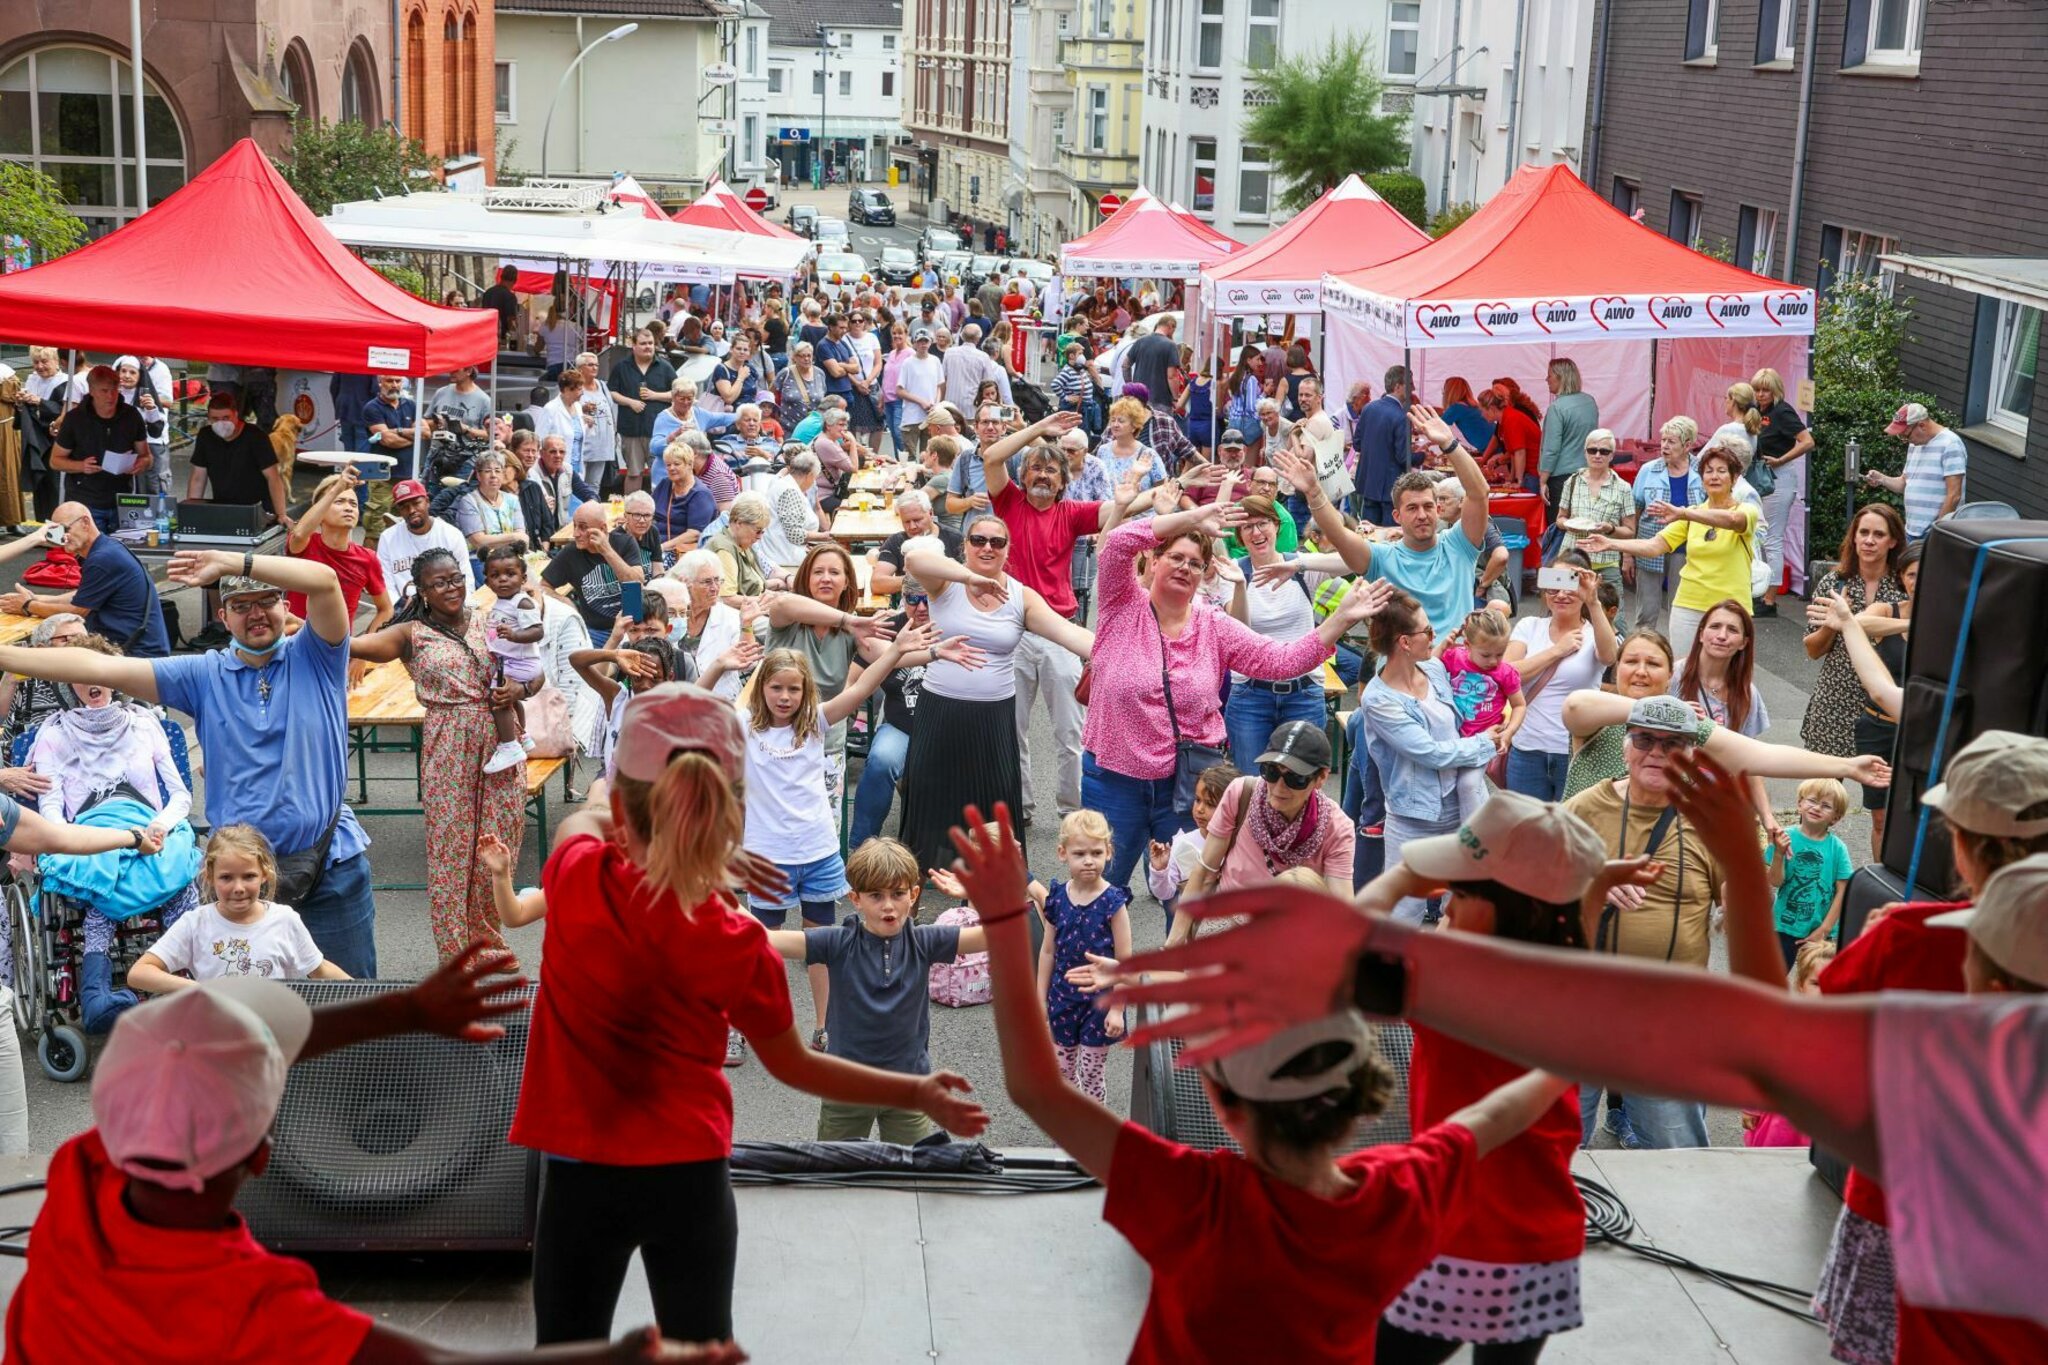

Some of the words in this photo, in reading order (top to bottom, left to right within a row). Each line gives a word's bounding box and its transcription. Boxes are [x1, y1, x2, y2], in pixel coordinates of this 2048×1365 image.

[1429, 315, 1461, 328] AWO
[1487, 312, 1519, 326] AWO
[1546, 309, 1577, 323] AWO
[1604, 307, 1635, 320] AWO
[1662, 305, 1692, 319] AWO
[1719, 304, 1750, 317] AWO
[1777, 303, 1808, 316] AWO
[1642, 703, 1687, 723] RAMS
